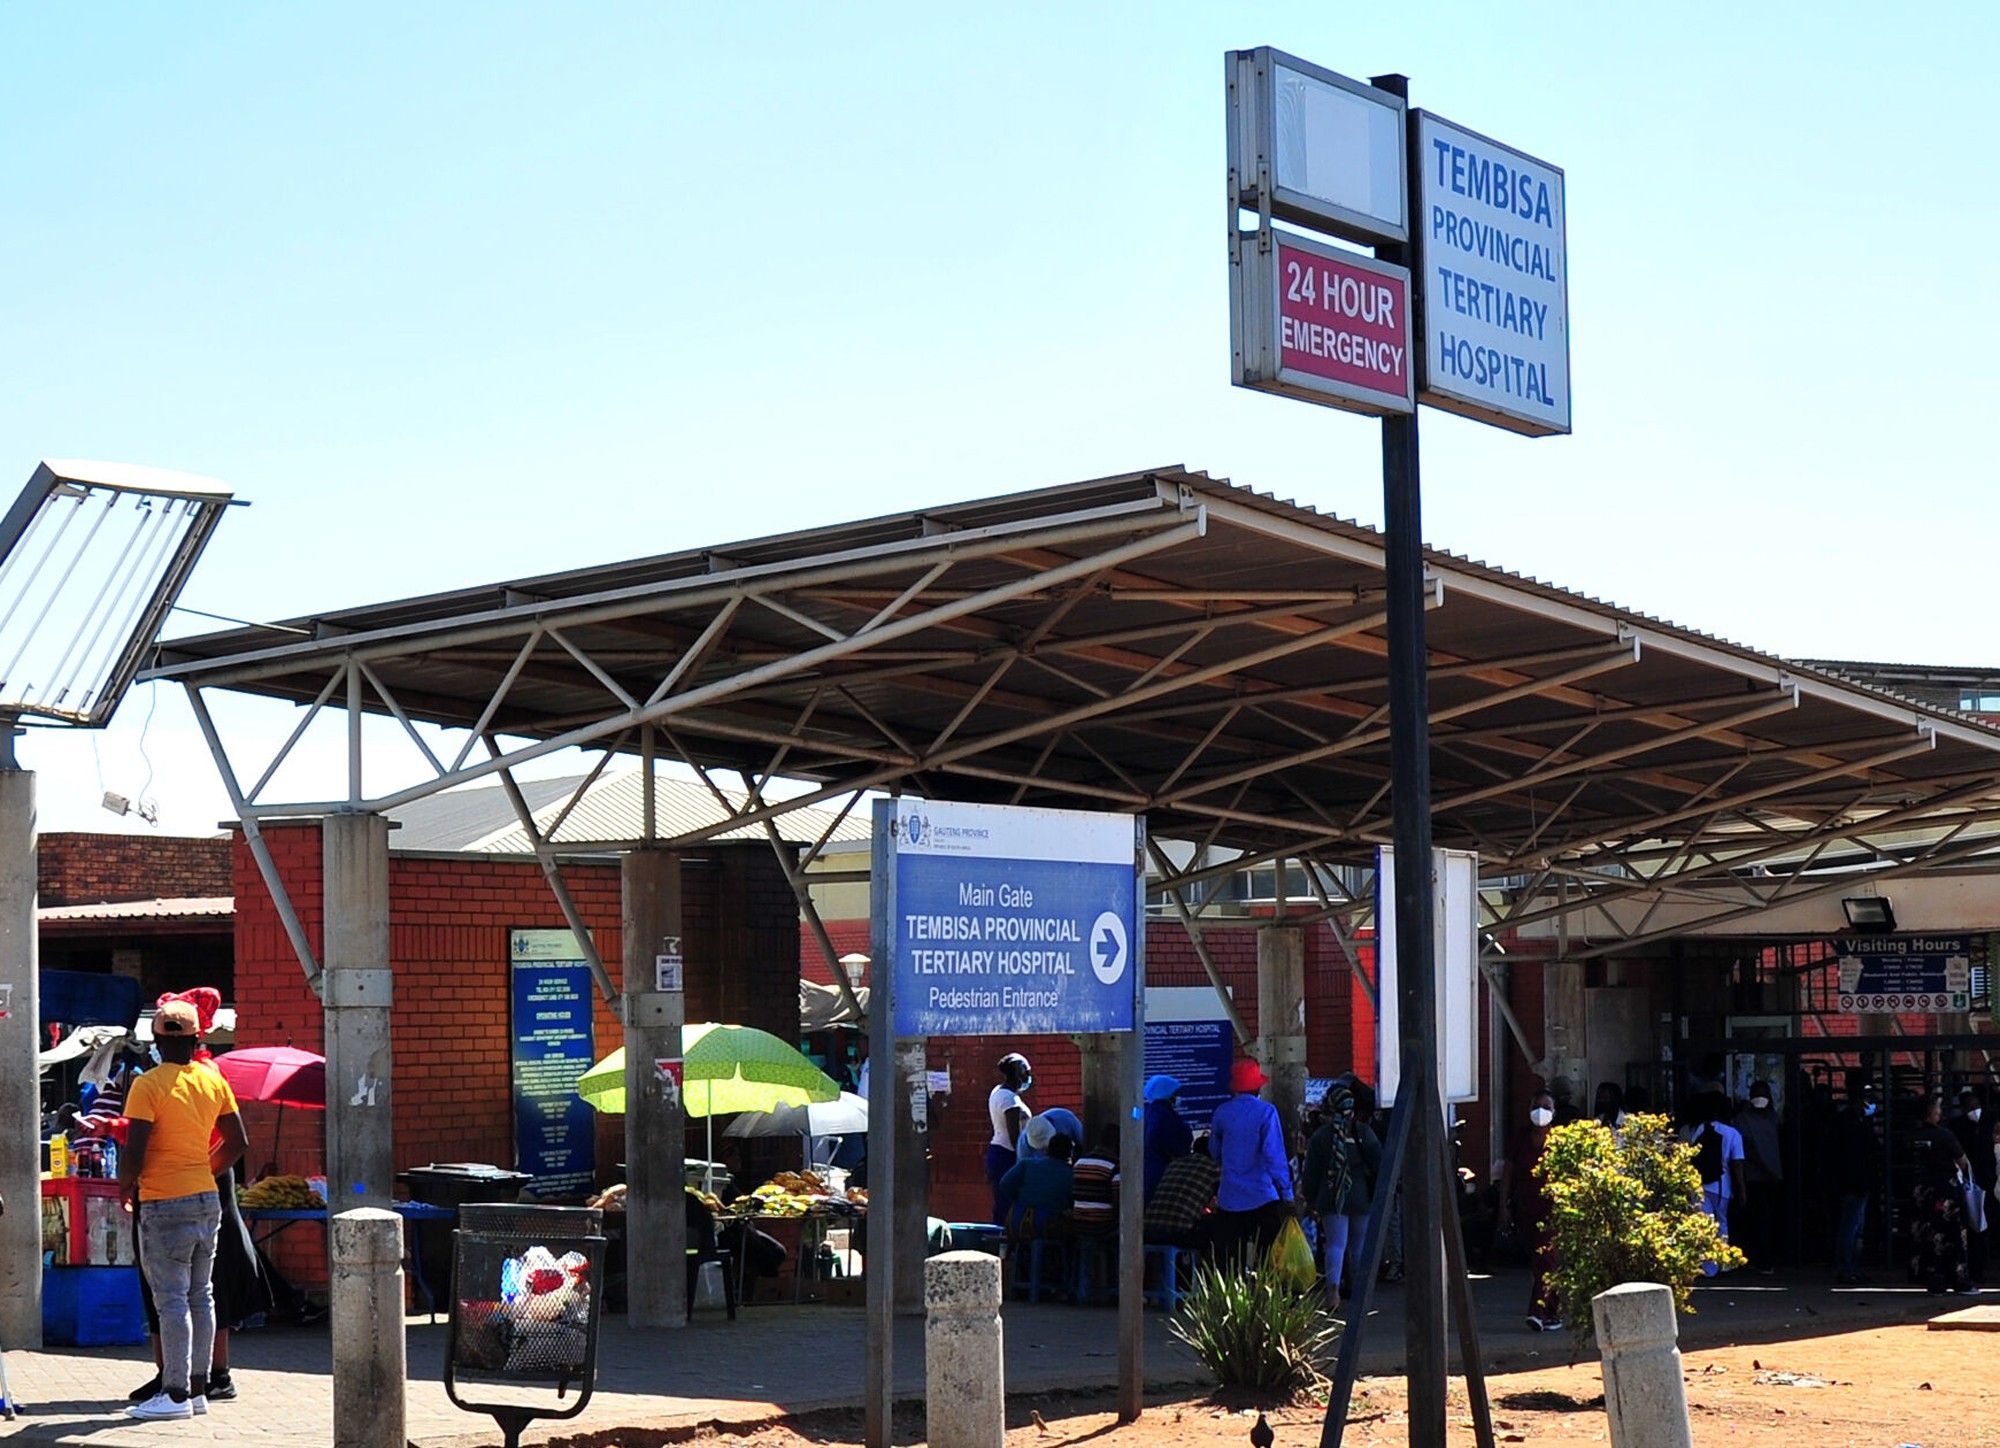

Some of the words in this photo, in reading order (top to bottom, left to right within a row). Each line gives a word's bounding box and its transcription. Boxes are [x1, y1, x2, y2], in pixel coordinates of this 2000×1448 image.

[1433, 137, 1553, 229] TEMBISA
[1433, 205, 1555, 282] PROVINCIAL
[1287, 260, 1316, 305] 24
[1323, 271, 1395, 328] HOUR
[1439, 266, 1547, 341] TERTIARY
[1281, 316, 1403, 377] EMERGENCY
[1440, 331, 1554, 406] HOSPITAL
[959, 882, 994, 907] Main
[999, 884, 1033, 908] Gate
[906, 915, 981, 940] TEMBISA
[985, 917, 1081, 942] PROVINCIAL
[1846, 939, 1907, 953] Visiting
[1912, 938, 1961, 951] Hours
[911, 950, 993, 974] TERTIARY
[998, 951, 1075, 975] HOSPITAL
[929, 986, 999, 1009] Pedestrian
[1003, 986, 1059, 1008] Entrance
[1168, 1024, 1194, 1034] TERTIARY
[1195, 1024, 1220, 1033] HOSPITAL
